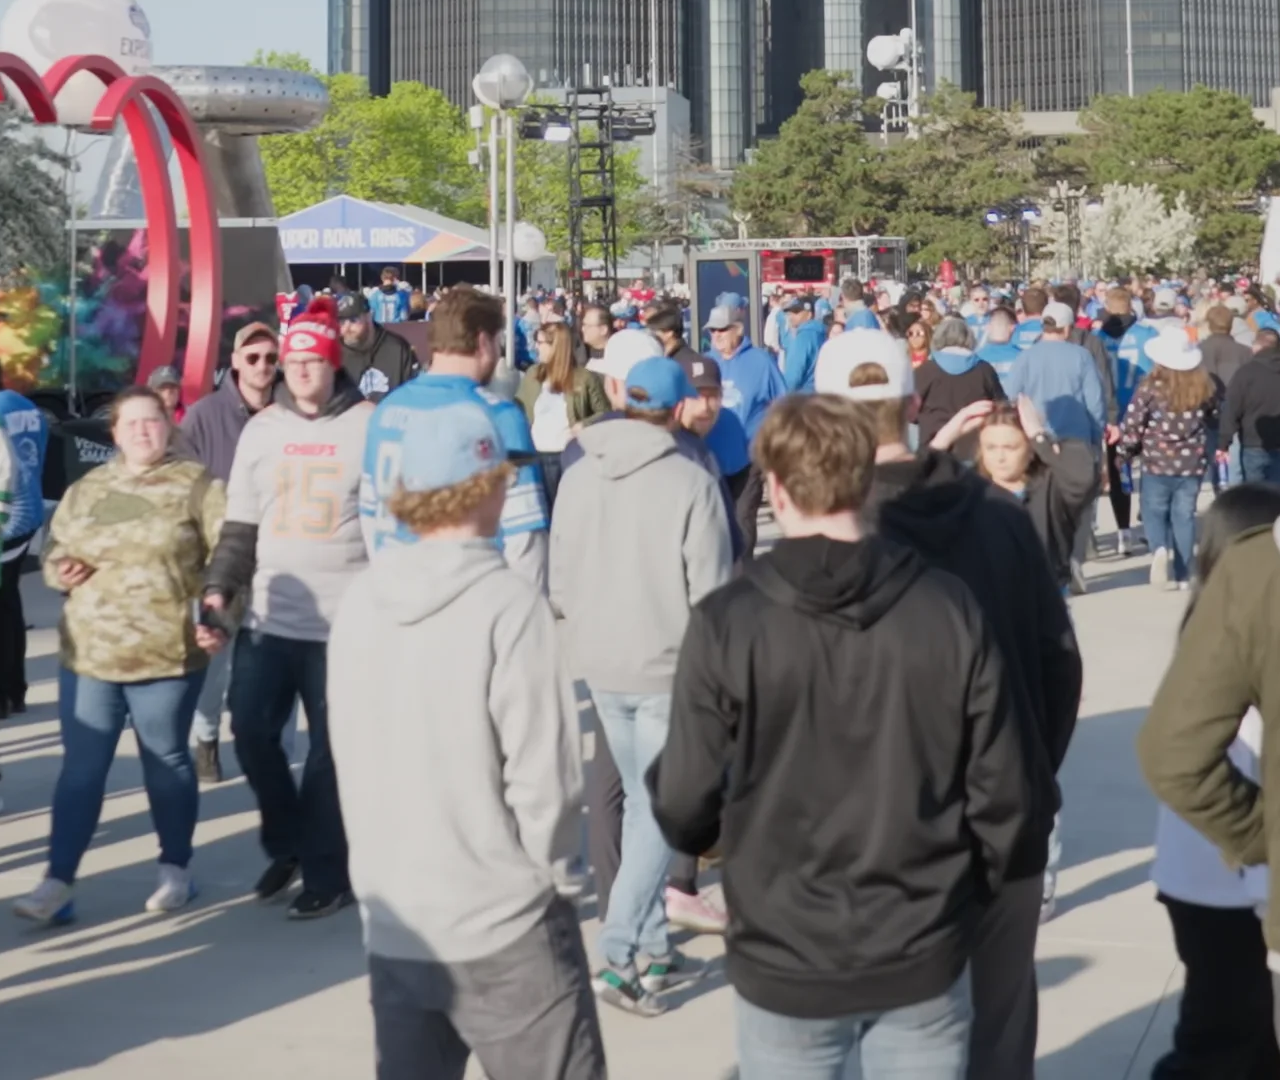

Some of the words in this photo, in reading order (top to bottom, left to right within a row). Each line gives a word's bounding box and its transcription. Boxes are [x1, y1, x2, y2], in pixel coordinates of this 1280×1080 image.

[323, 228, 366, 249] BOWL
[283, 443, 337, 456] CHIEFS
[272, 460, 343, 540] 15
